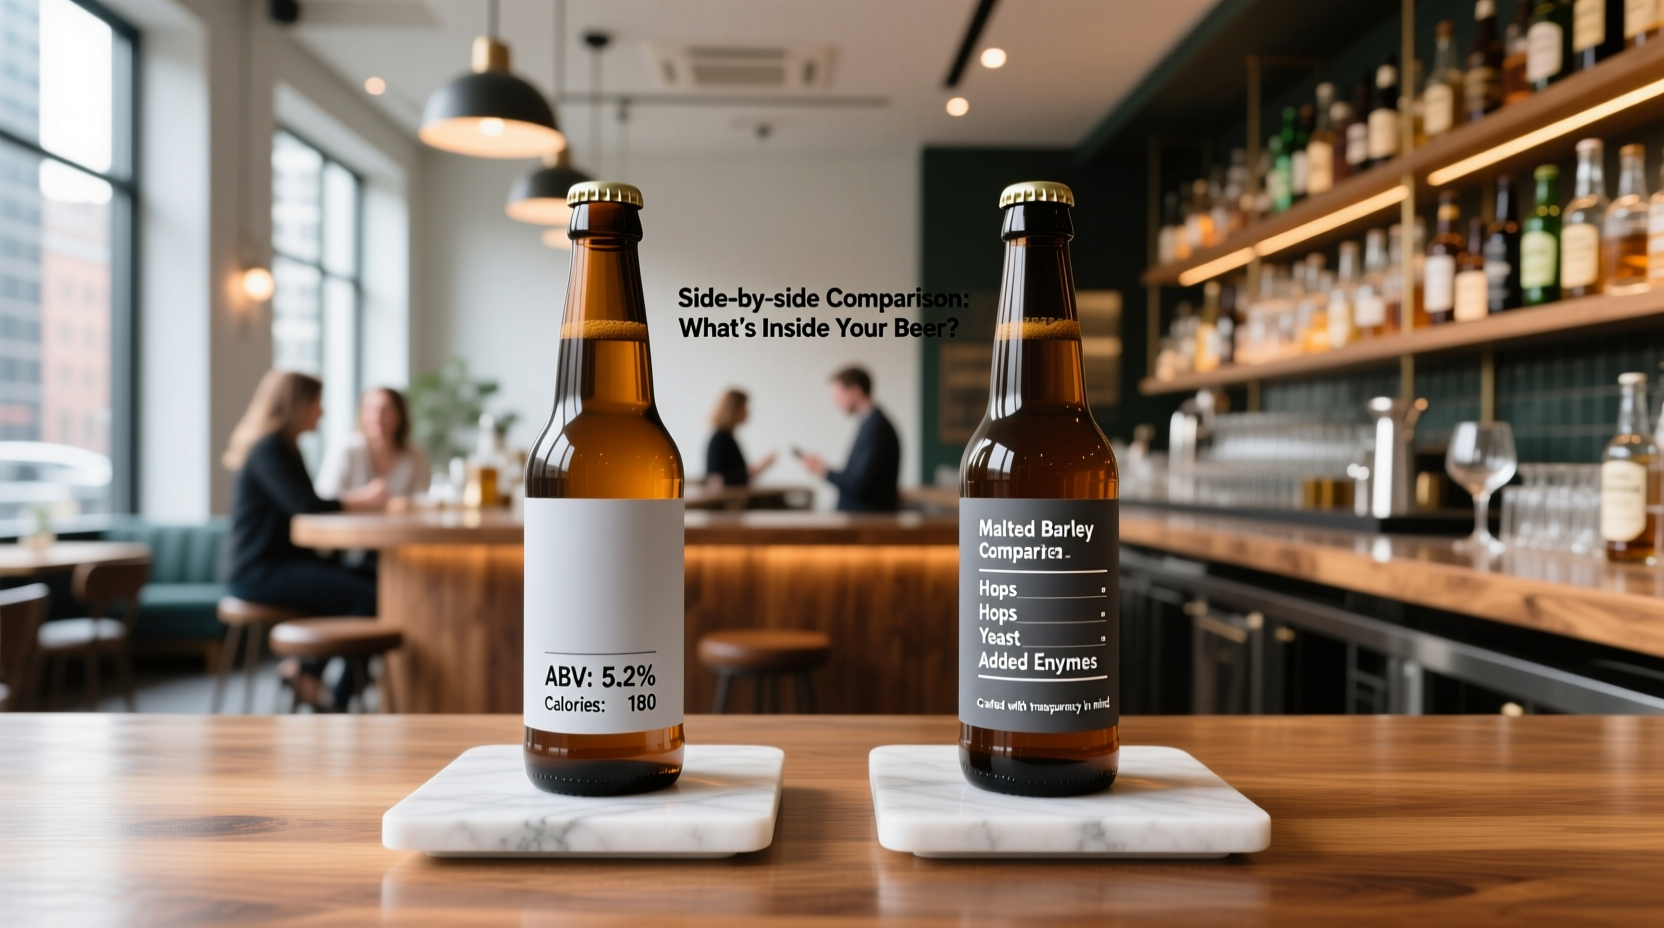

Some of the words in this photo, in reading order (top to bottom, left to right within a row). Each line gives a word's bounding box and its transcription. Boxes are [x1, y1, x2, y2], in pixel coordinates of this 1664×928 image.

[979, 519, 1035, 538] Malted
[1041, 519, 1094, 543] Barley
[979, 579, 1018, 601] Hops
[979, 603, 1018, 625] Hops
[979, 627, 1021, 646] Yeast
[978, 651, 1028, 670] Added
[1034, 652, 1098, 675] Enymes
[545, 665, 593, 688] ABV:
[602, 664, 656, 688] 5.2%
[544, 695, 605, 713] Calories:
[628, 693, 656, 712] 180
